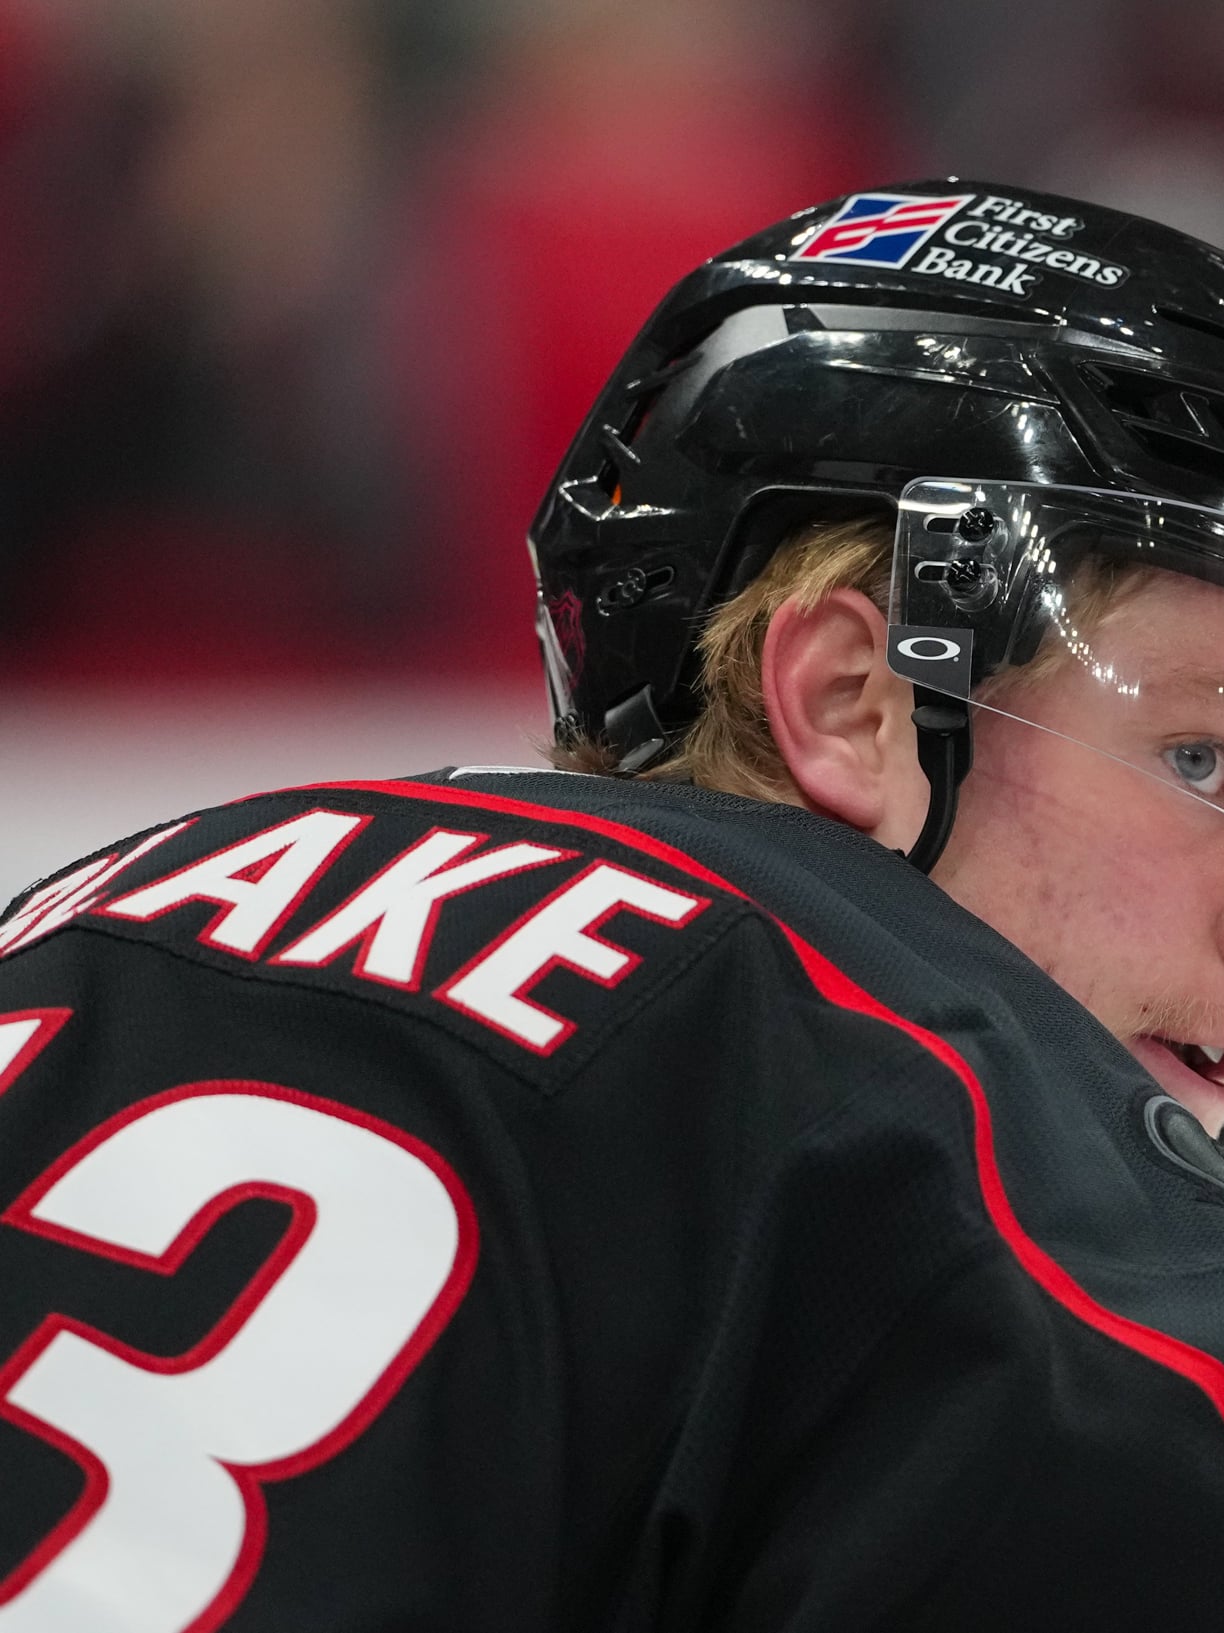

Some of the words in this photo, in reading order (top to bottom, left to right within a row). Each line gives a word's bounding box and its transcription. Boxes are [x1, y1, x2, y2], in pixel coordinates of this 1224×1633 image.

[967, 195, 1079, 237] First
[911, 246, 1036, 295] Bank
[943, 219, 1127, 286] Citizens
[0, 1006, 480, 1633] 3
